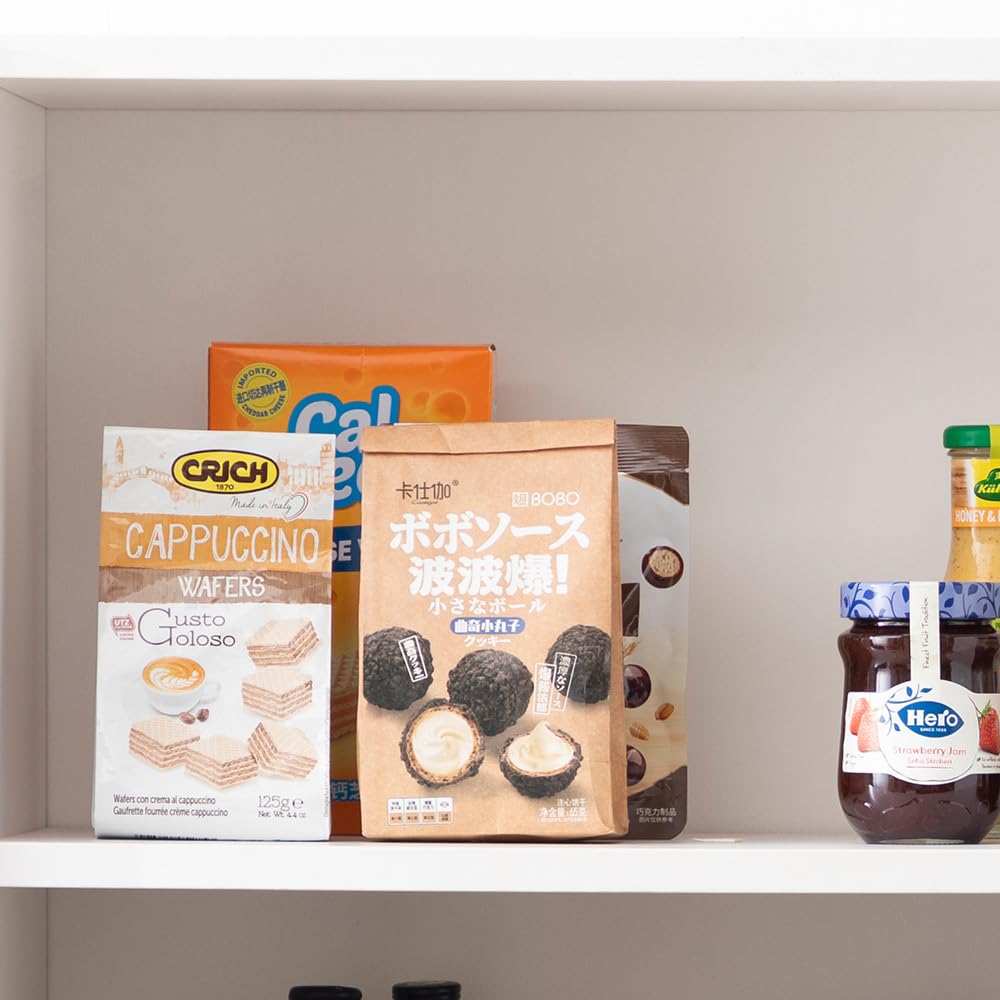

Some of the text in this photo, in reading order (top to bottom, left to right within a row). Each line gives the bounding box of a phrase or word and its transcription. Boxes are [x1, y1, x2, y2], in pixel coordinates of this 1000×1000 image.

[237, 367, 277, 389] IMPORTED
[181, 459, 268, 484] CRICH
[231, 496, 256, 509] Made
[531, 491, 581, 507] BOBO
[126, 522, 320, 564] CAPPUCCINO
[178, 575, 266, 599] WAFERS
[906, 709, 959, 727] Hero
[894, 746, 967, 757] Strawberry Jam
[113, 794, 136, 804] Wafers
[171, 796, 178, 804] al
[178, 796, 216, 806] cappuccino
[258, 795, 290, 811] 125g
[113, 806, 144, 815] Gaufrette
[191, 808, 228, 818] cappuccino
